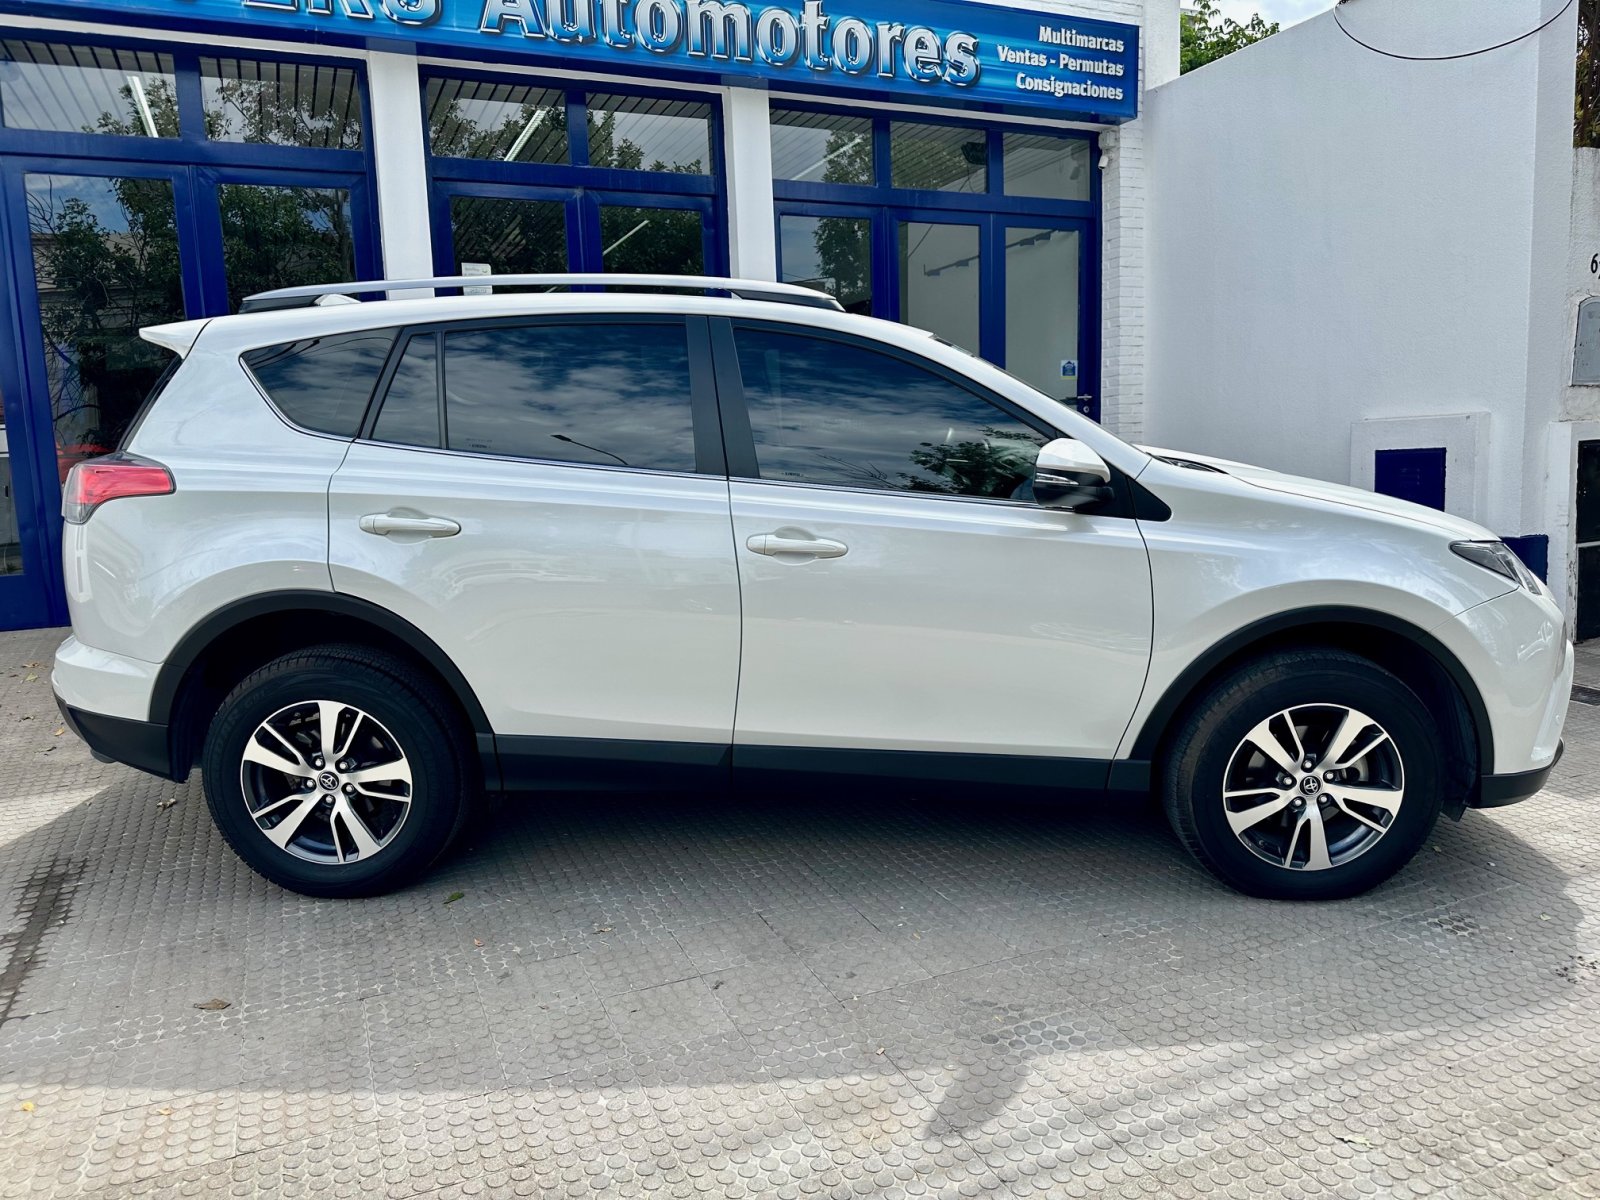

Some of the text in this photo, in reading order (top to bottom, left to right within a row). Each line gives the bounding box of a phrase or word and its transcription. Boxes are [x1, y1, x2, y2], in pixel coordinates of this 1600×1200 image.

[1038, 25, 1124, 52] Multimarcas
[996, 44, 1047, 67] Ventas
[1059, 52, 1124, 76] Permutas
[1015, 72, 1123, 100] Consignaciones
